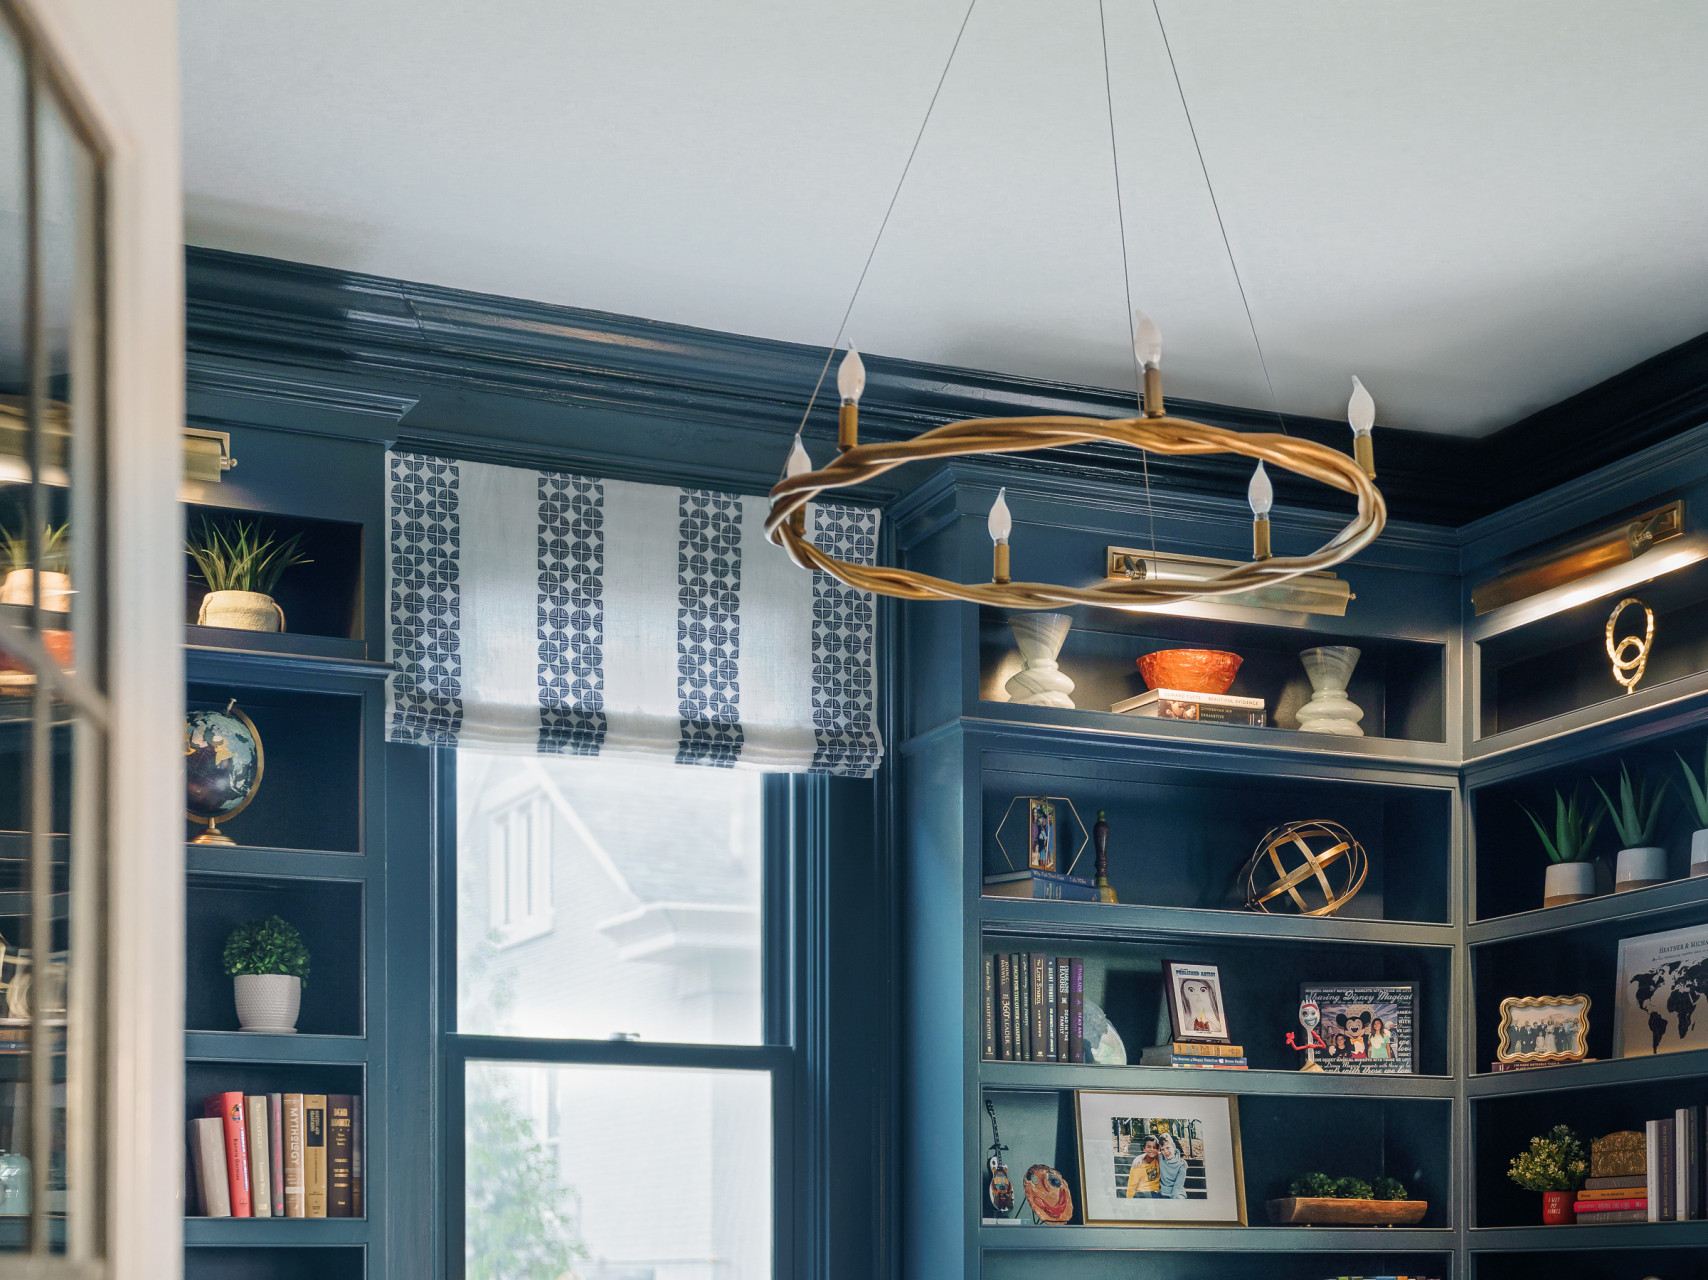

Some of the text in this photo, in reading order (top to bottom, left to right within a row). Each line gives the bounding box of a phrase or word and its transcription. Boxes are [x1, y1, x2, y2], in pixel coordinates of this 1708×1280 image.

[1659, 944, 1684, 953] HEATHER
[1343, 990, 1375, 1004] Disney
[1377, 991, 1412, 1004] Magical
[1341, 1066, 1361, 1074] with
[333, 1108, 348, 1117] DEAN
[290, 1108, 299, 1165] MYTHOLOGY
